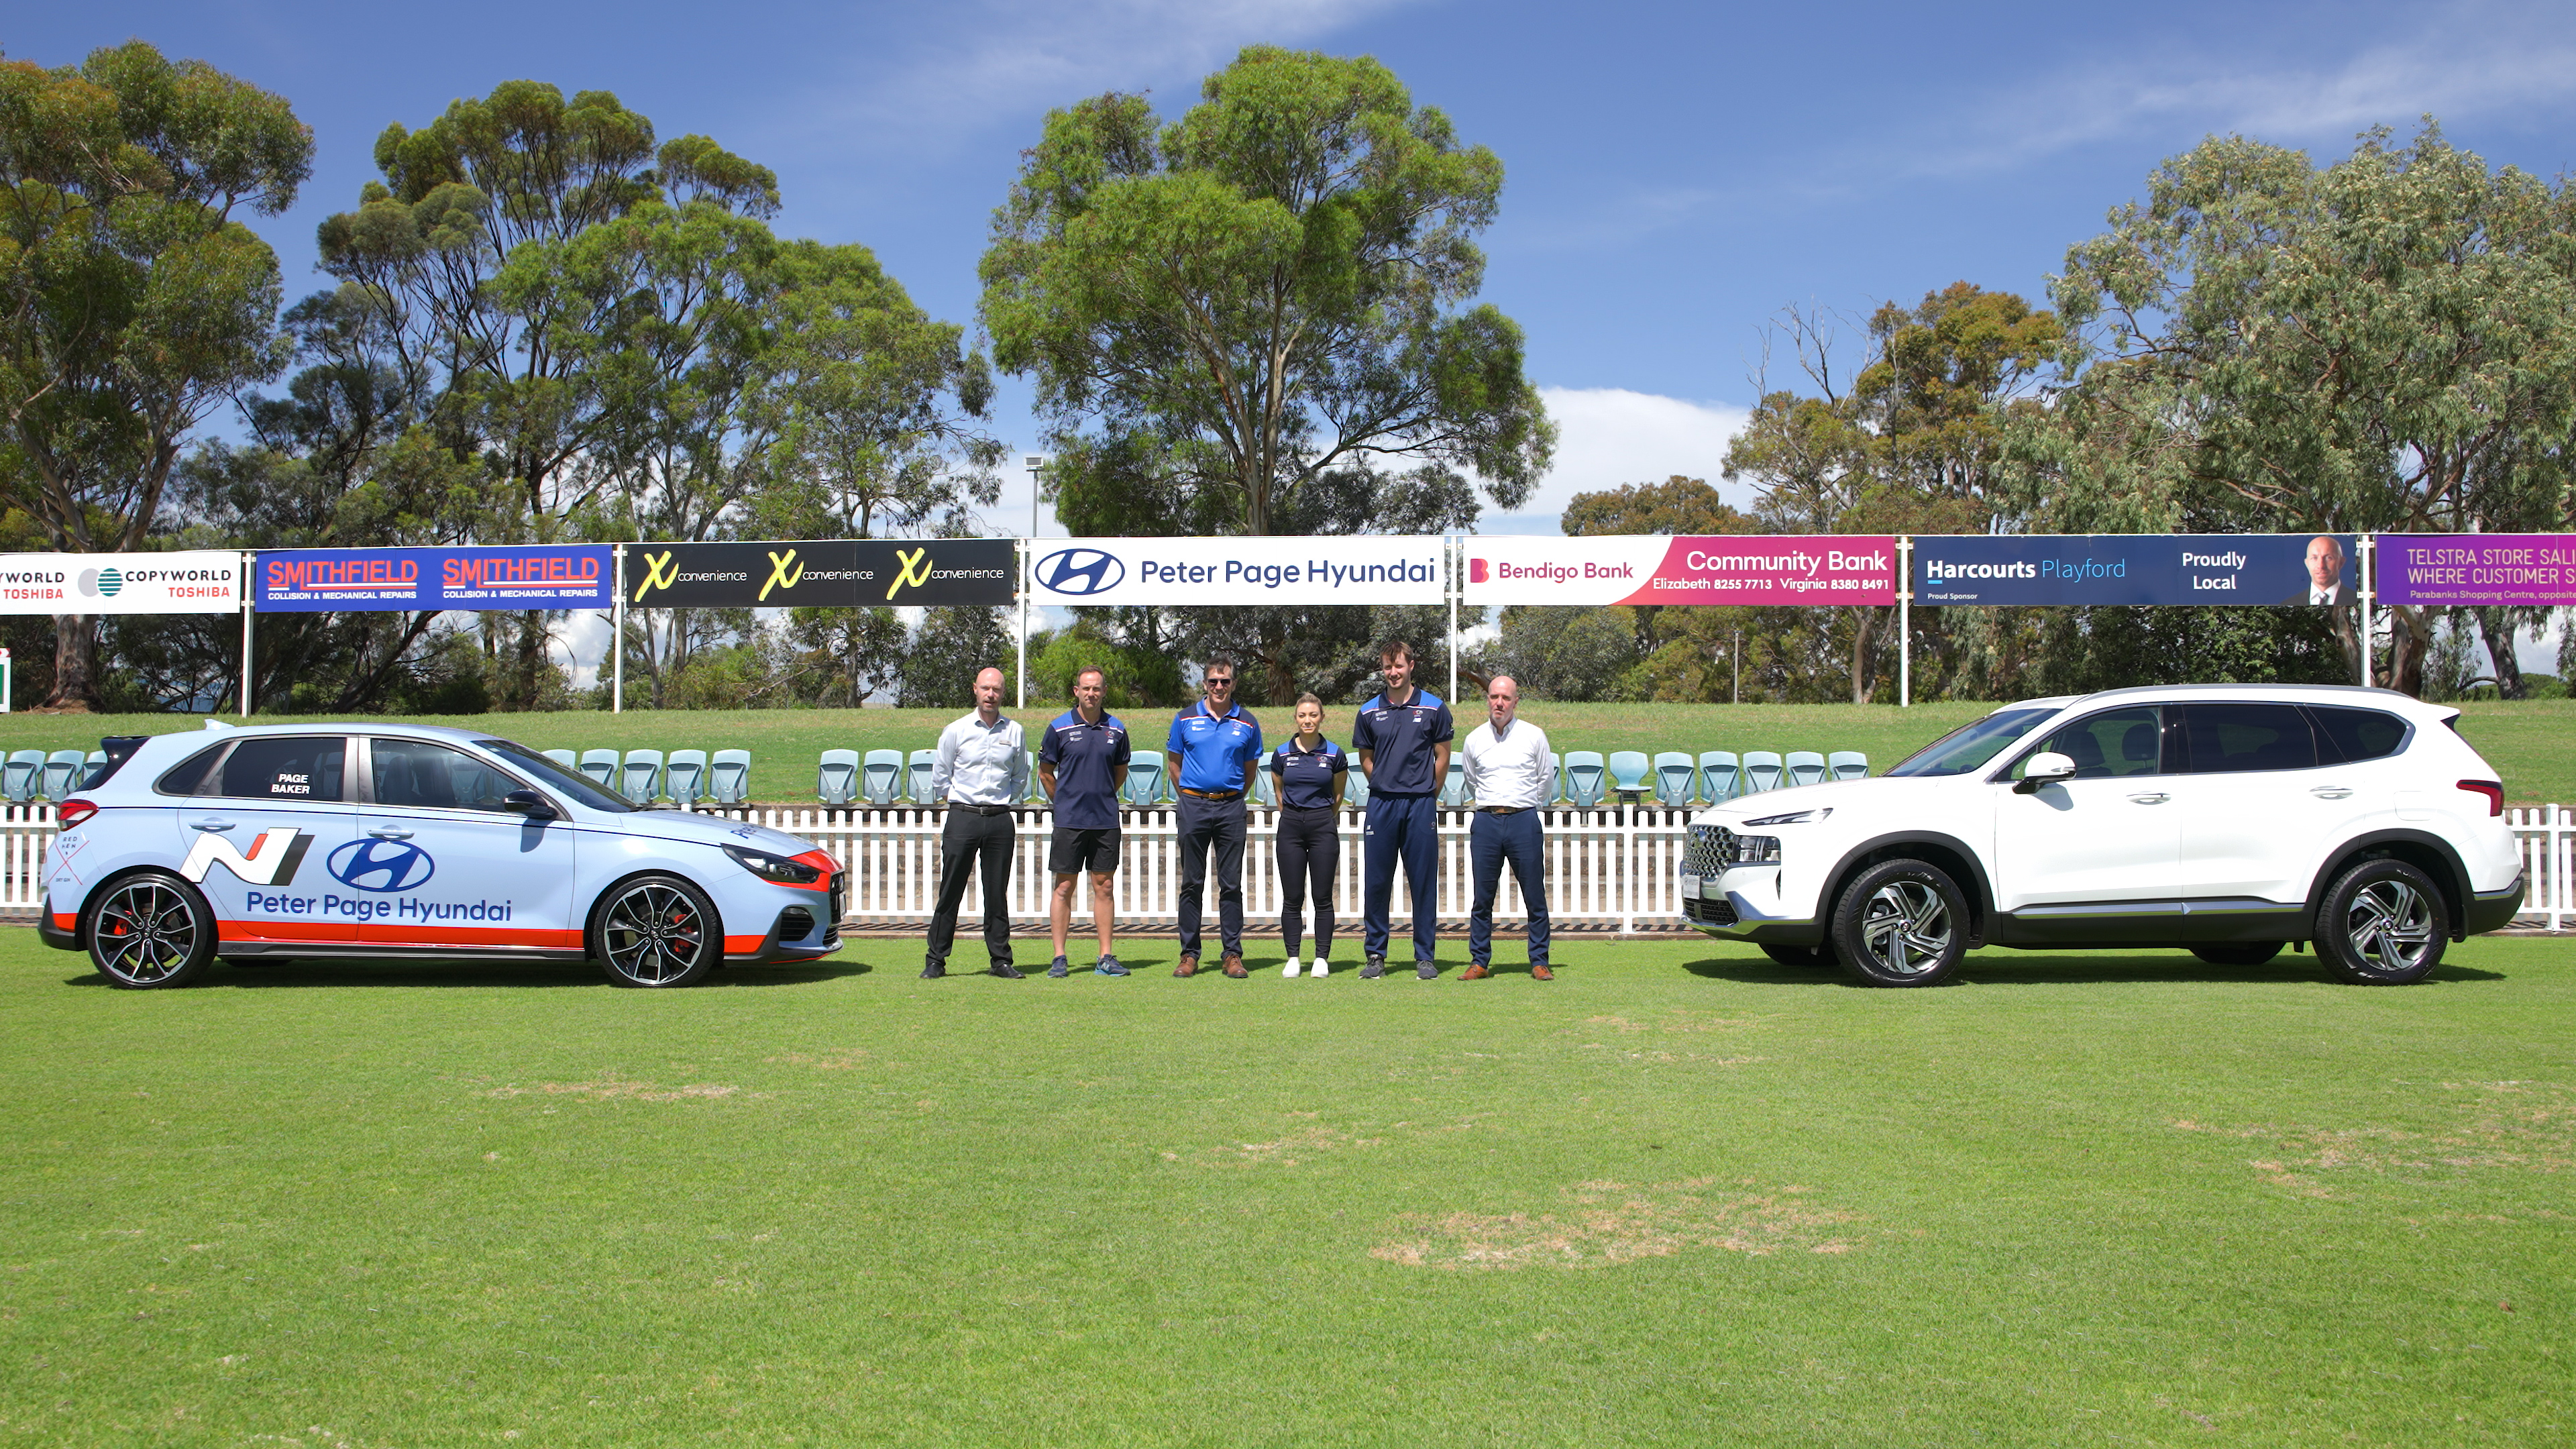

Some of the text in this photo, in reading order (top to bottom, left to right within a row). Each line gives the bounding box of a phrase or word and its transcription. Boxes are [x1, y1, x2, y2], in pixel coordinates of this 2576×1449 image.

[1686, 550, 1888, 576] Community Bank
[2182, 551, 2246, 570] Proudly
[2407, 549, 2575, 564] TELSTRA STORE SALI
[125, 570, 231, 582] COPYWORLD
[268, 560, 418, 586] SMITHFIELD
[443, 557, 599, 583] SMITHFIELD
[1141, 557, 1434, 588] Peter Page Hyundai
[1499, 562, 1633, 583] Bendigo Bank
[1927, 558, 2125, 582] Harcourts Playford
[2407, 568, 2467, 584] WHERE
[2473, 568, 2559, 584] CUSTOMER
[1653, 578, 1888, 592] Elizabeth 8255 7713 Virginia 8380 8491
[2193, 575, 2236, 589] Local
[3, 589, 64, 599] TOSHIBA
[168, 587, 230, 597] TOSHIBA
[559, 589, 598, 597] REPAIRS
[1949, 592, 1978, 600] Sponsor
[2410, 590, 2457, 598] Parabanks
[2459, 590, 2502, 600] Shopping
[2504, 590, 2537, 600] Centre,
[278, 773, 309, 783] PAGE
[271, 784, 311, 794] BAKER
[247, 892, 511, 922] Peter Page Hyundai
